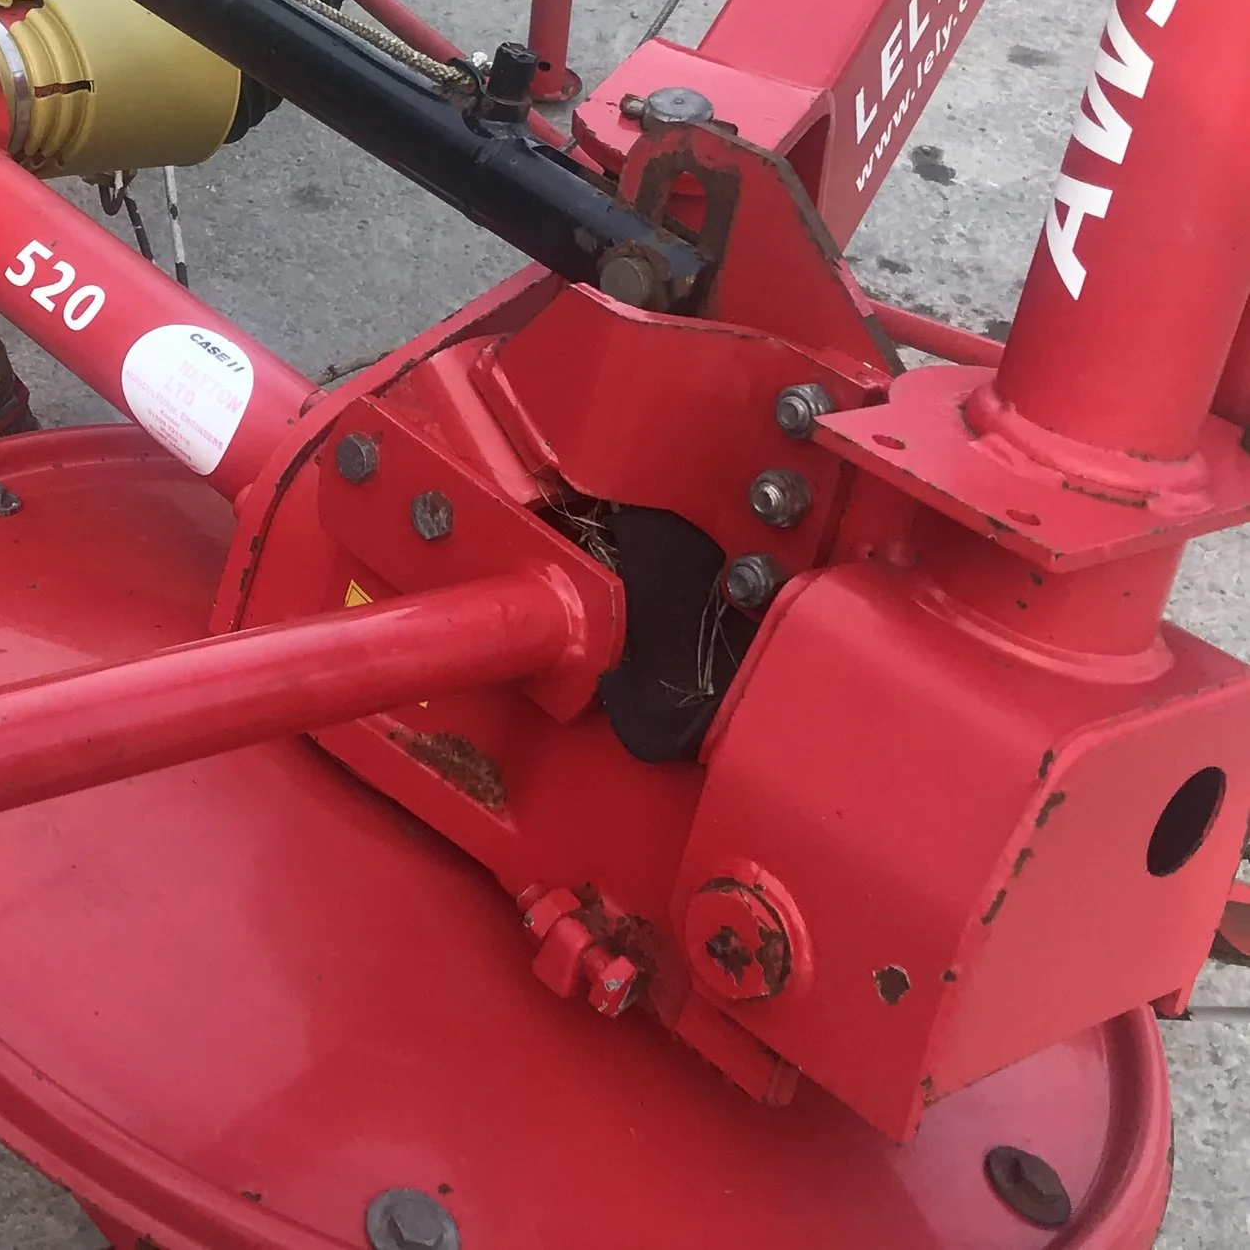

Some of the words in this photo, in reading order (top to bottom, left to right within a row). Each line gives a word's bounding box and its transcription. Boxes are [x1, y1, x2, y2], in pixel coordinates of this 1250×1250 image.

[4, 239, 106, 331] 520
[189, 333, 231, 362] CASE
[179, 410, 224, 451] ENGINEERS
